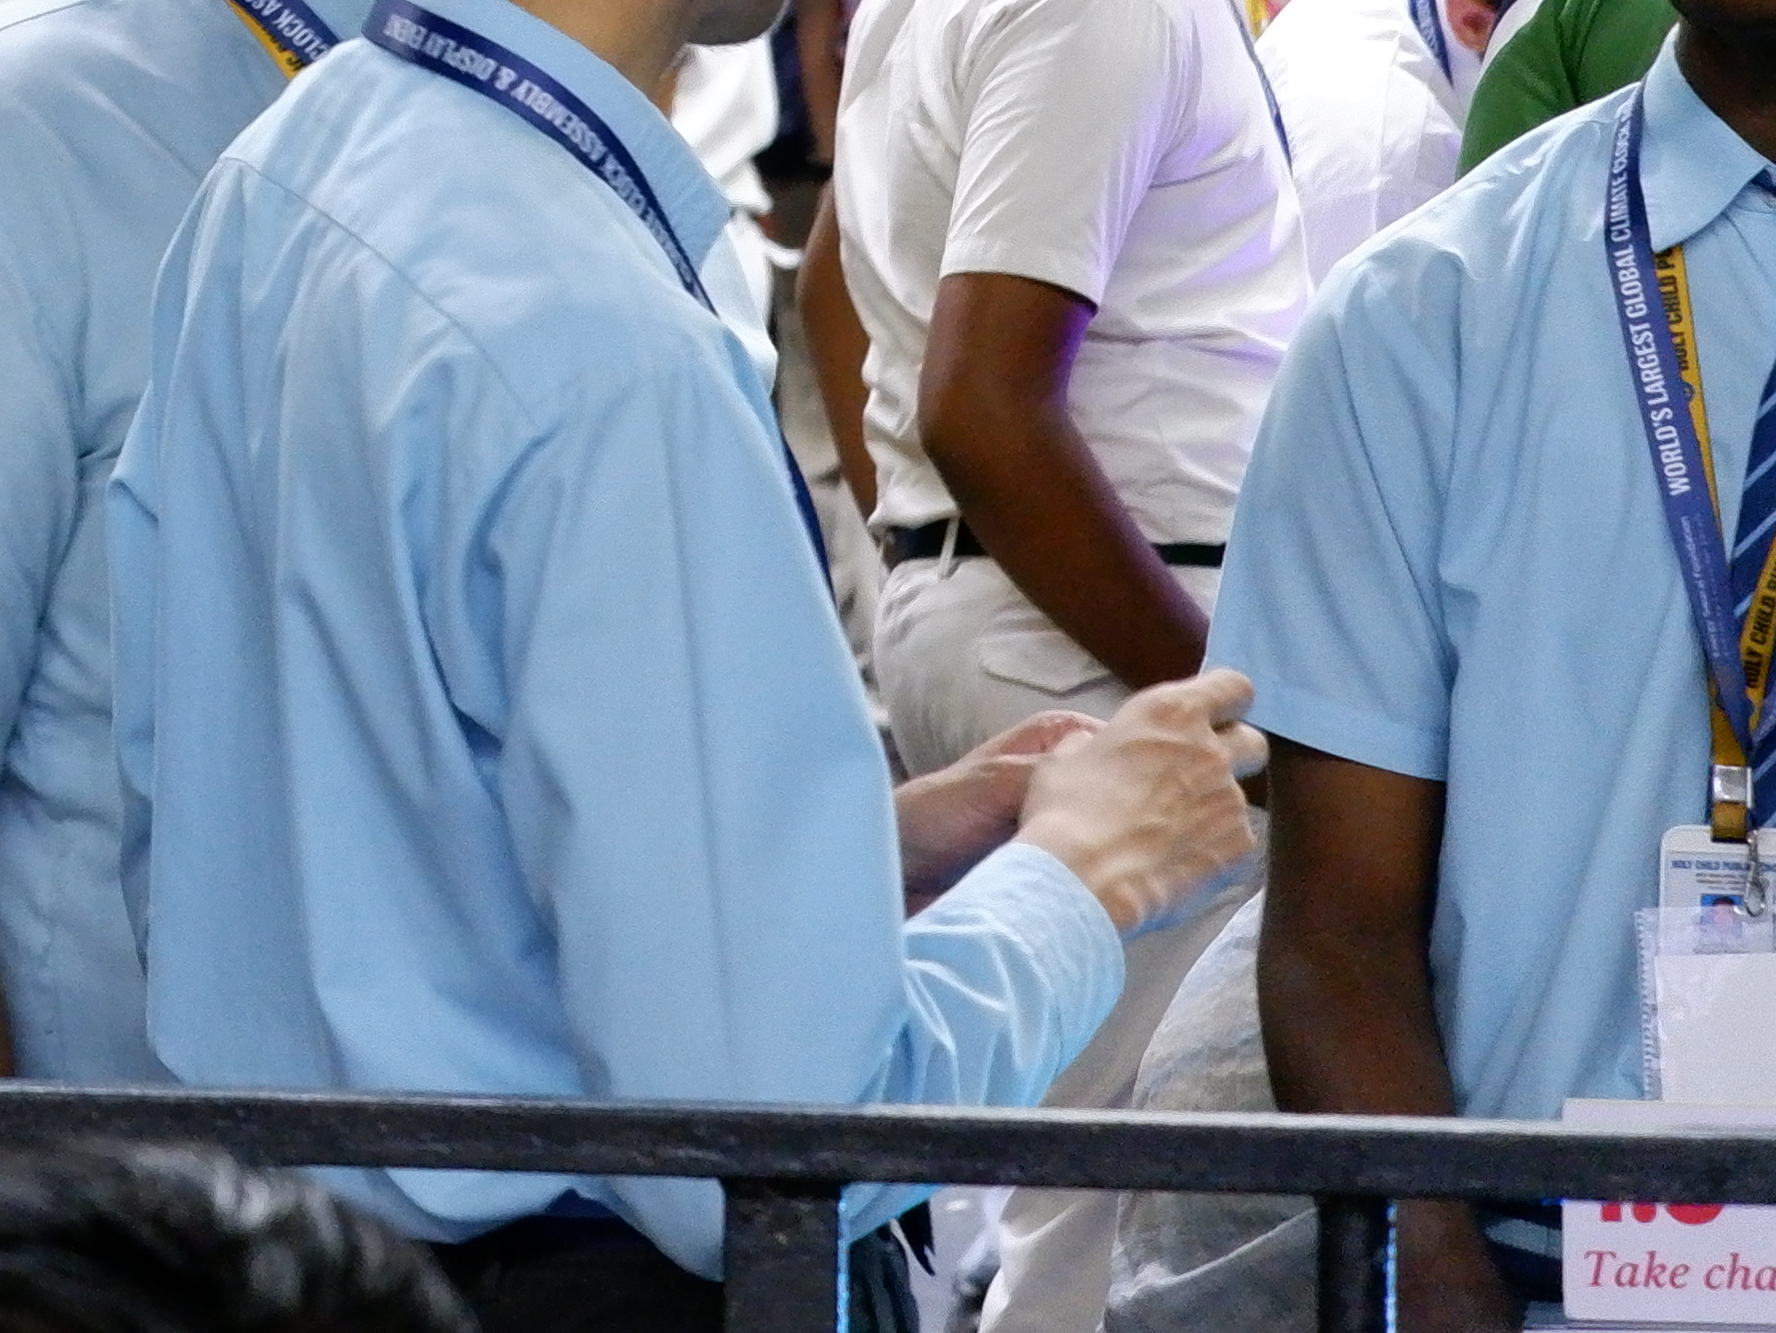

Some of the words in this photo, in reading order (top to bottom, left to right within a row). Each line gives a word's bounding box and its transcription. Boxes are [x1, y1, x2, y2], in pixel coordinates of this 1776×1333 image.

[1617, 244, 1647, 319] GLOBAL
[1633, 321, 1671, 402] LARGEST
[1653, 406, 1691, 495] WORLD'S
[1751, 594, 1776, 645] CHILD
[1584, 1250, 1690, 1290] Take
